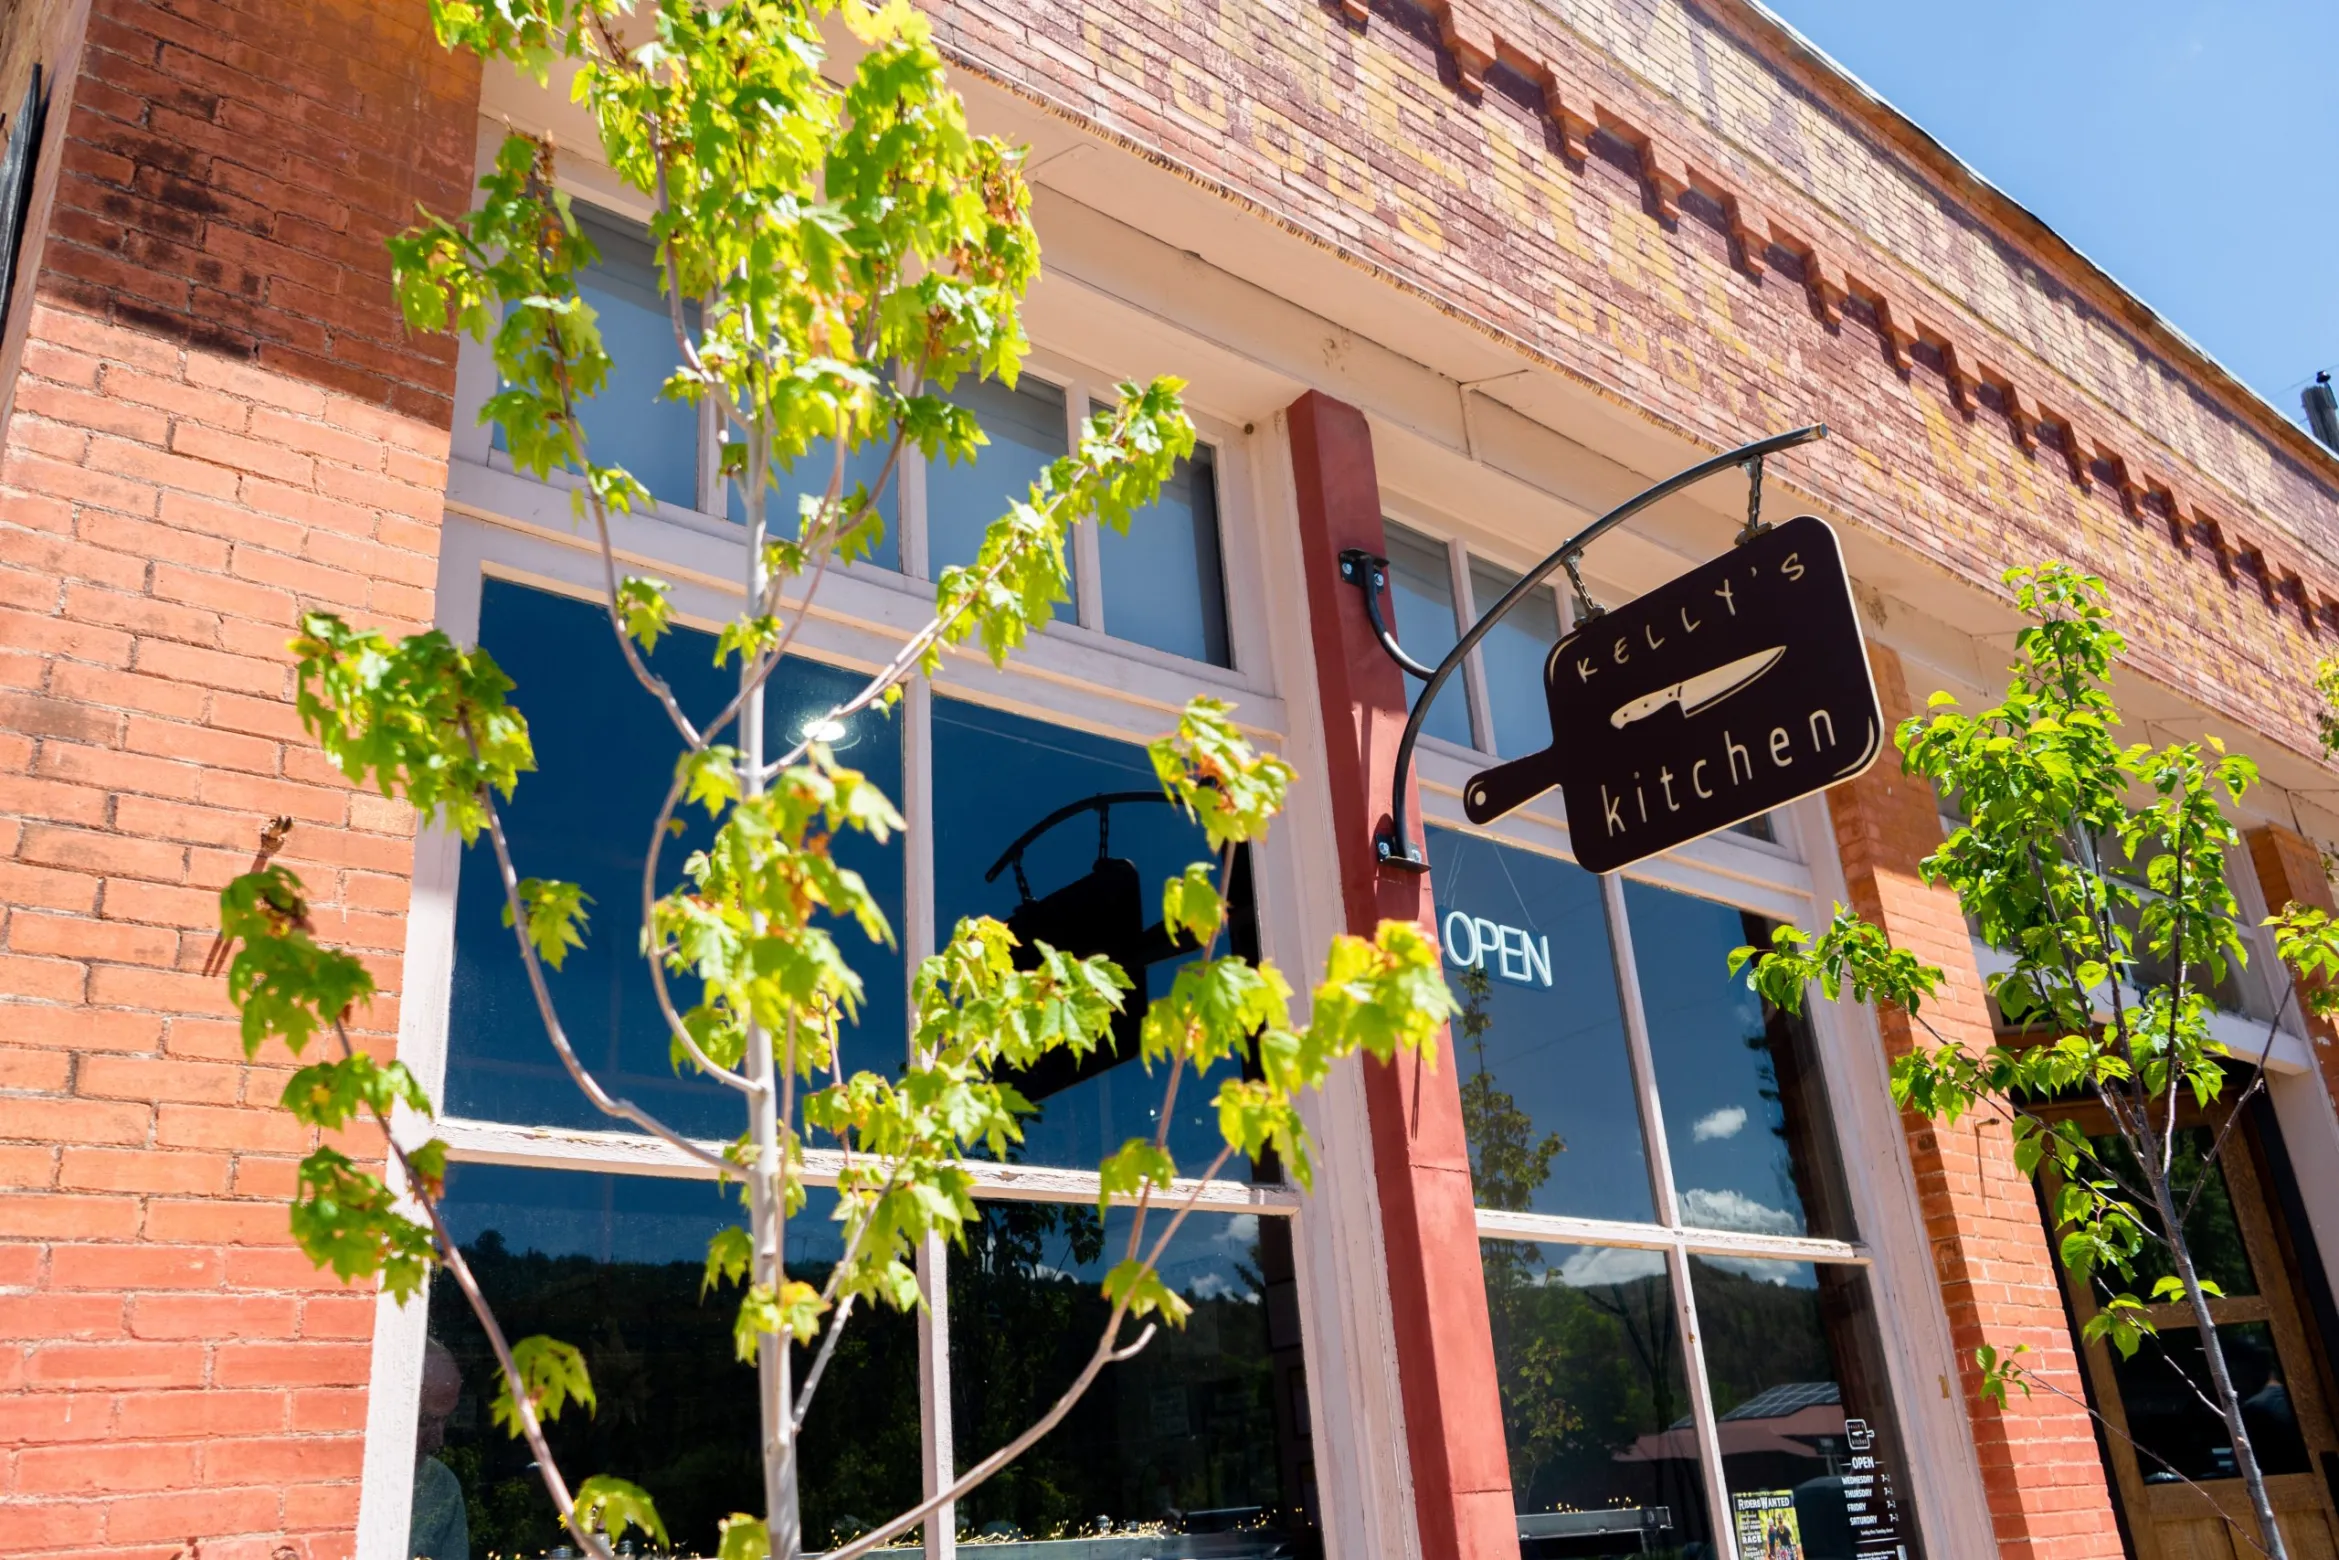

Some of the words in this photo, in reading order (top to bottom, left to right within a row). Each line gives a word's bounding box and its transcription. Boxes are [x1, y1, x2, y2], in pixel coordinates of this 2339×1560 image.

[1082, 3, 1446, 255] GOODS
[1155, 0, 1784, 378] NERAL
[1577, 552, 1805, 684] KELLY'S
[1601, 708, 1837, 838] kitchen
[1443, 910, 1553, 988] OPEN
[1841, 1474, 1874, 1485] WEDNESDAY
[1852, 1456, 1875, 1470] OPEN
[1844, 1488, 1872, 1498] THURSDAY
[1846, 1502, 1867, 1512] FRIDAY
[1849, 1515, 1878, 1526] SATURDAY
